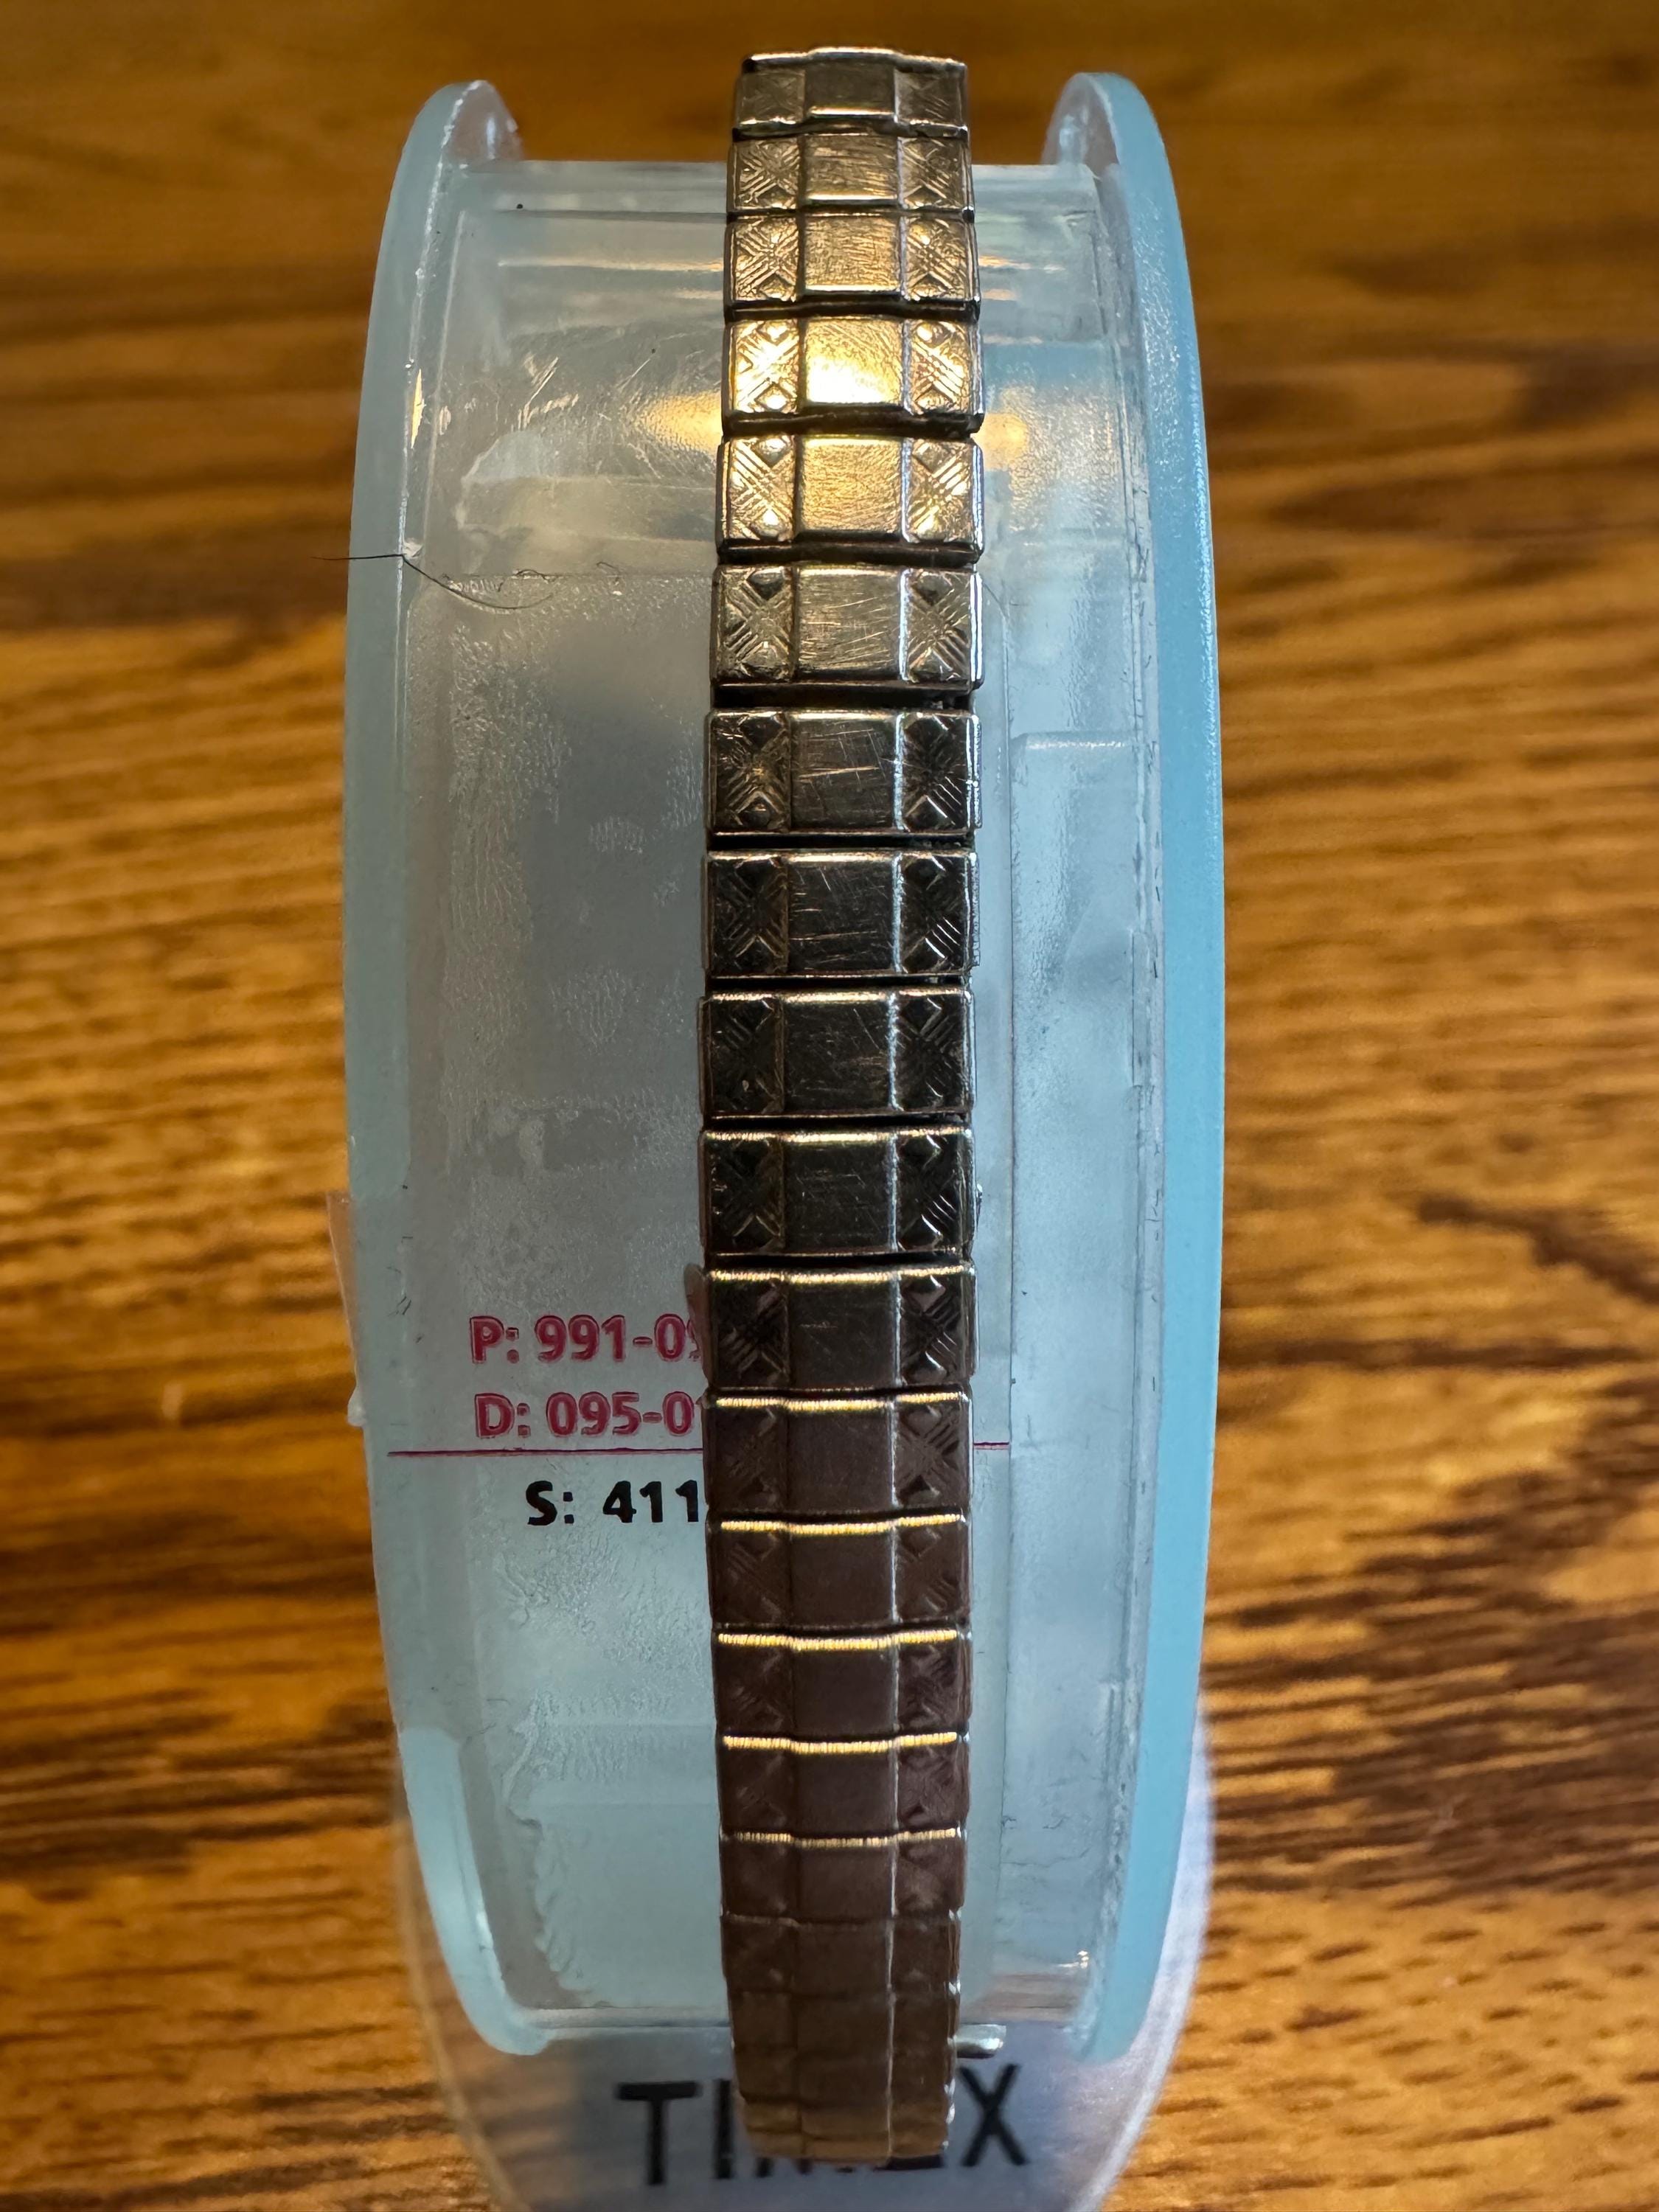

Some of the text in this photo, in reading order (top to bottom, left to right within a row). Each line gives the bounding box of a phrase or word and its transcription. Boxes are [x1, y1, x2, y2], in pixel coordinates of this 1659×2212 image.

[469, 1315, 520, 1364] P:
[474, 1391, 700, 1438] D: 095-0
[526, 1480, 574, 1526] S:
[616, 2063, 1028, 2187] TIX
